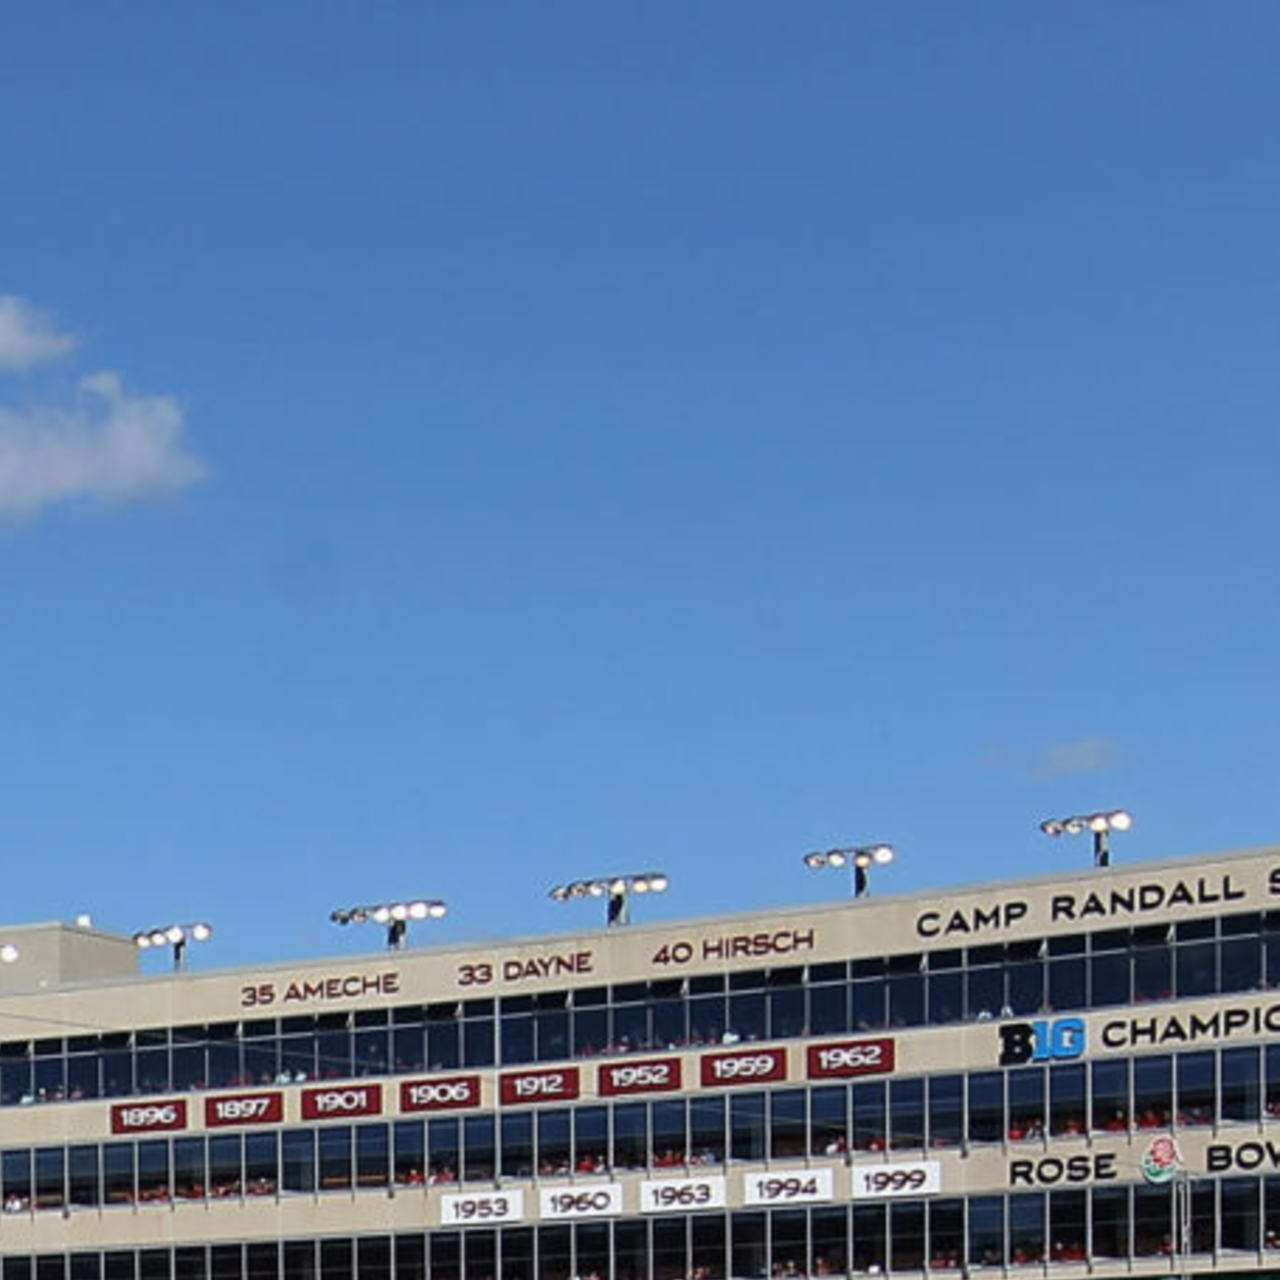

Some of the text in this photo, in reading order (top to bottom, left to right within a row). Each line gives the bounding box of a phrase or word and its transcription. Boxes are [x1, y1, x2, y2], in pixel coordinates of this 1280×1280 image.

[916, 902, 1028, 938] CAMP
[1052, 875, 1245, 921] RANDALL
[653, 929, 814, 965] 40 HIRSCH
[458, 952, 593, 985] 33 DAYNE
[241, 973, 400, 1006] 35 AMECHE
[712, 1054, 774, 1078] 1959
[819, 1044, 882, 1069] 1962
[512, 1072, 564, 1096] 1912
[610, 1063, 669, 1087] 1952
[315, 1089, 367, 1112] 1901
[410, 1081, 470, 1105] 1906
[120, 1104, 177, 1128] 1896
[215, 1096, 271, 1119] 1897
[863, 1169, 926, 1191] 1999
[1009, 1153, 1117, 1185] ROSE
[652, 1184, 712, 1205] 1963
[756, 1177, 818, 1198] 1994
[452, 1199, 508, 1219] 1953
[550, 1190, 611, 1211] 1960
